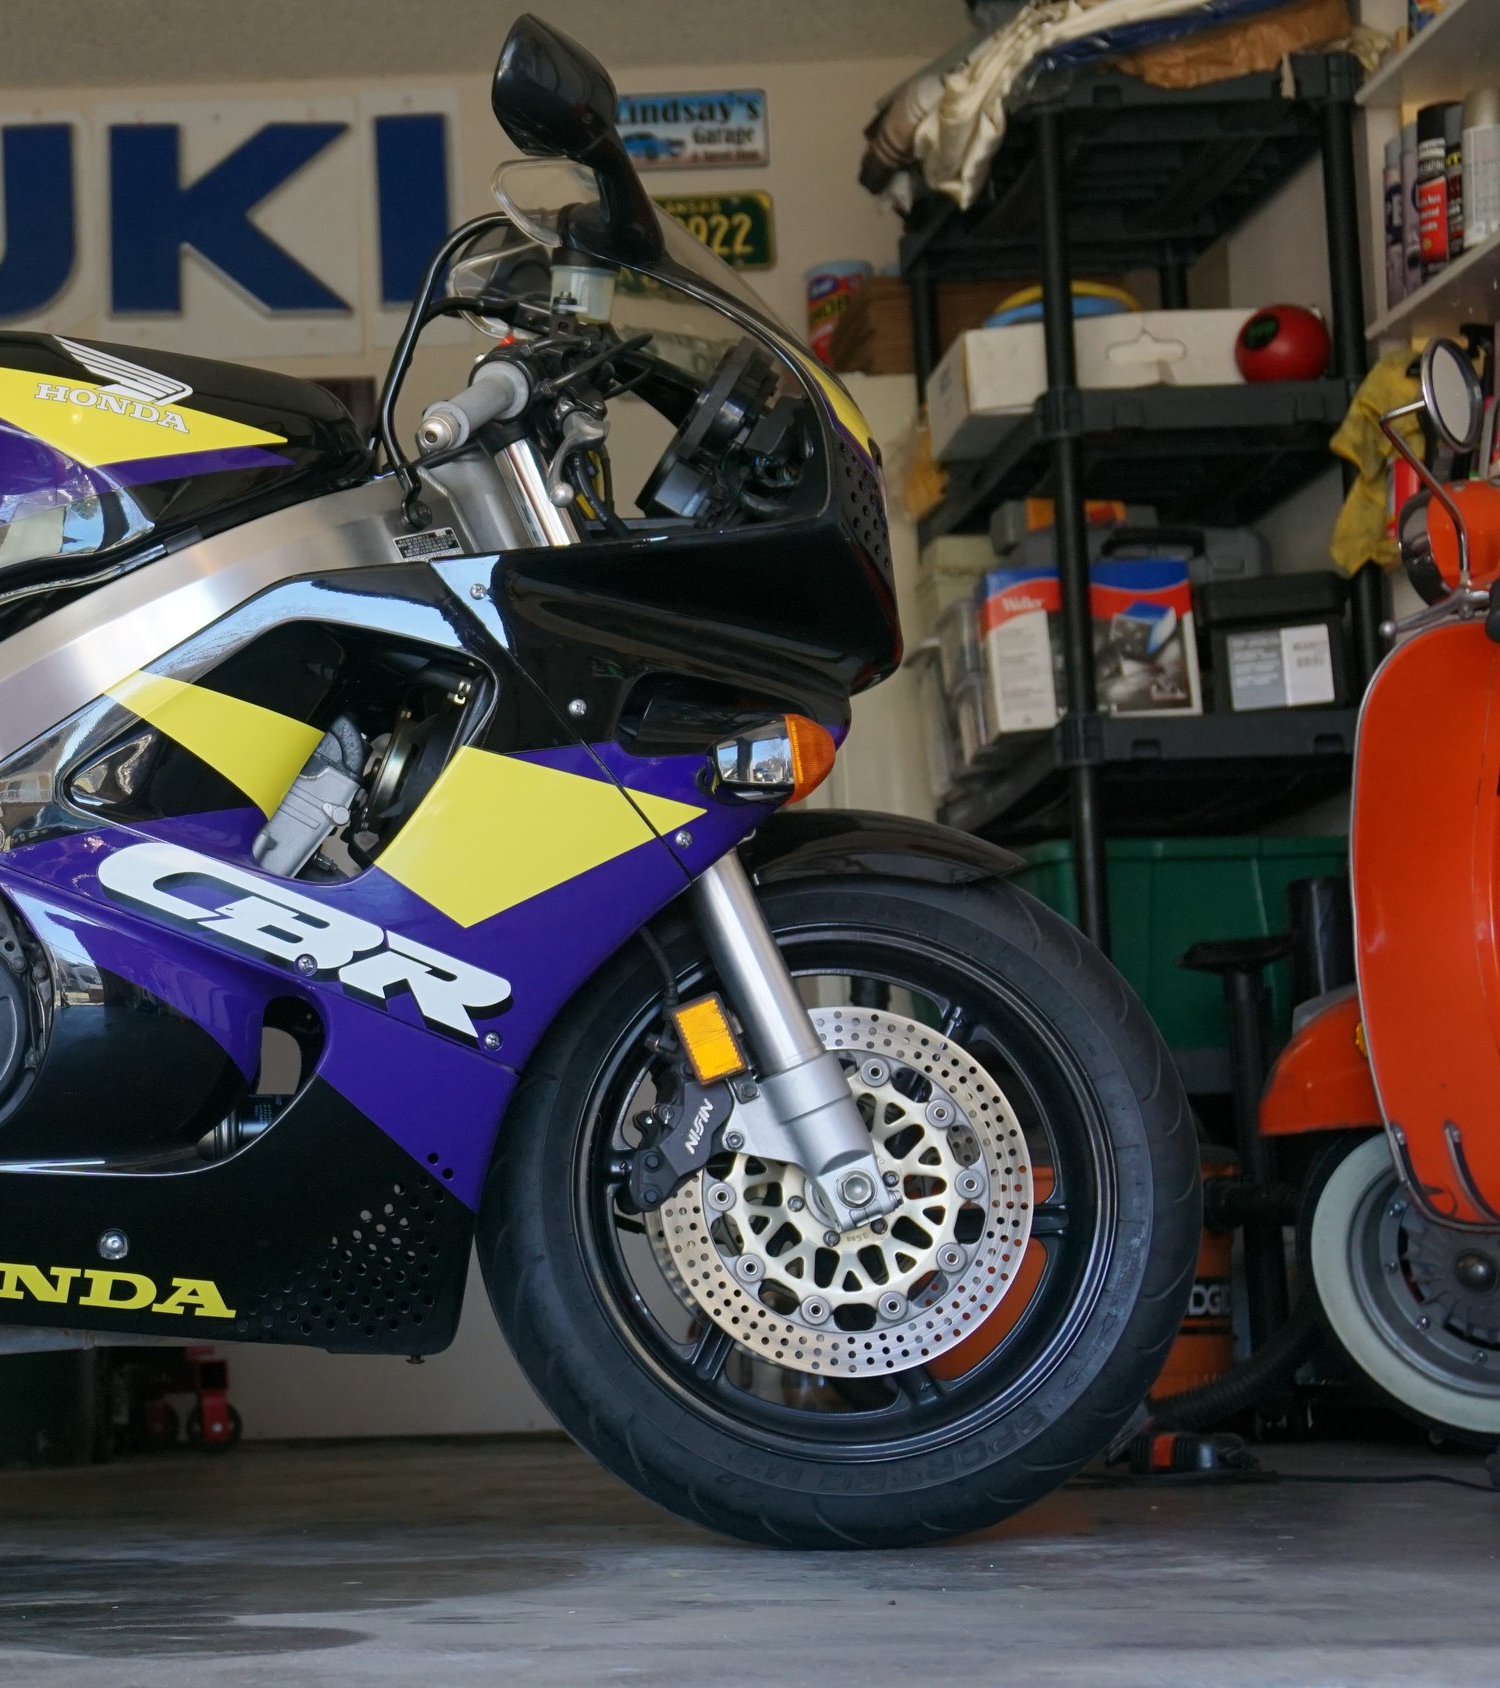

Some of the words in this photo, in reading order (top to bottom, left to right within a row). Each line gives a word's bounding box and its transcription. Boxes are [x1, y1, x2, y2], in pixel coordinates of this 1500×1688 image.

[692, 126, 754, 146] Garage
[680, 213, 754, 255] 922
[34, 383, 190, 434] HONDA
[1002, 595, 1045, 612] Weller
[98, 842, 513, 1041] CBR
